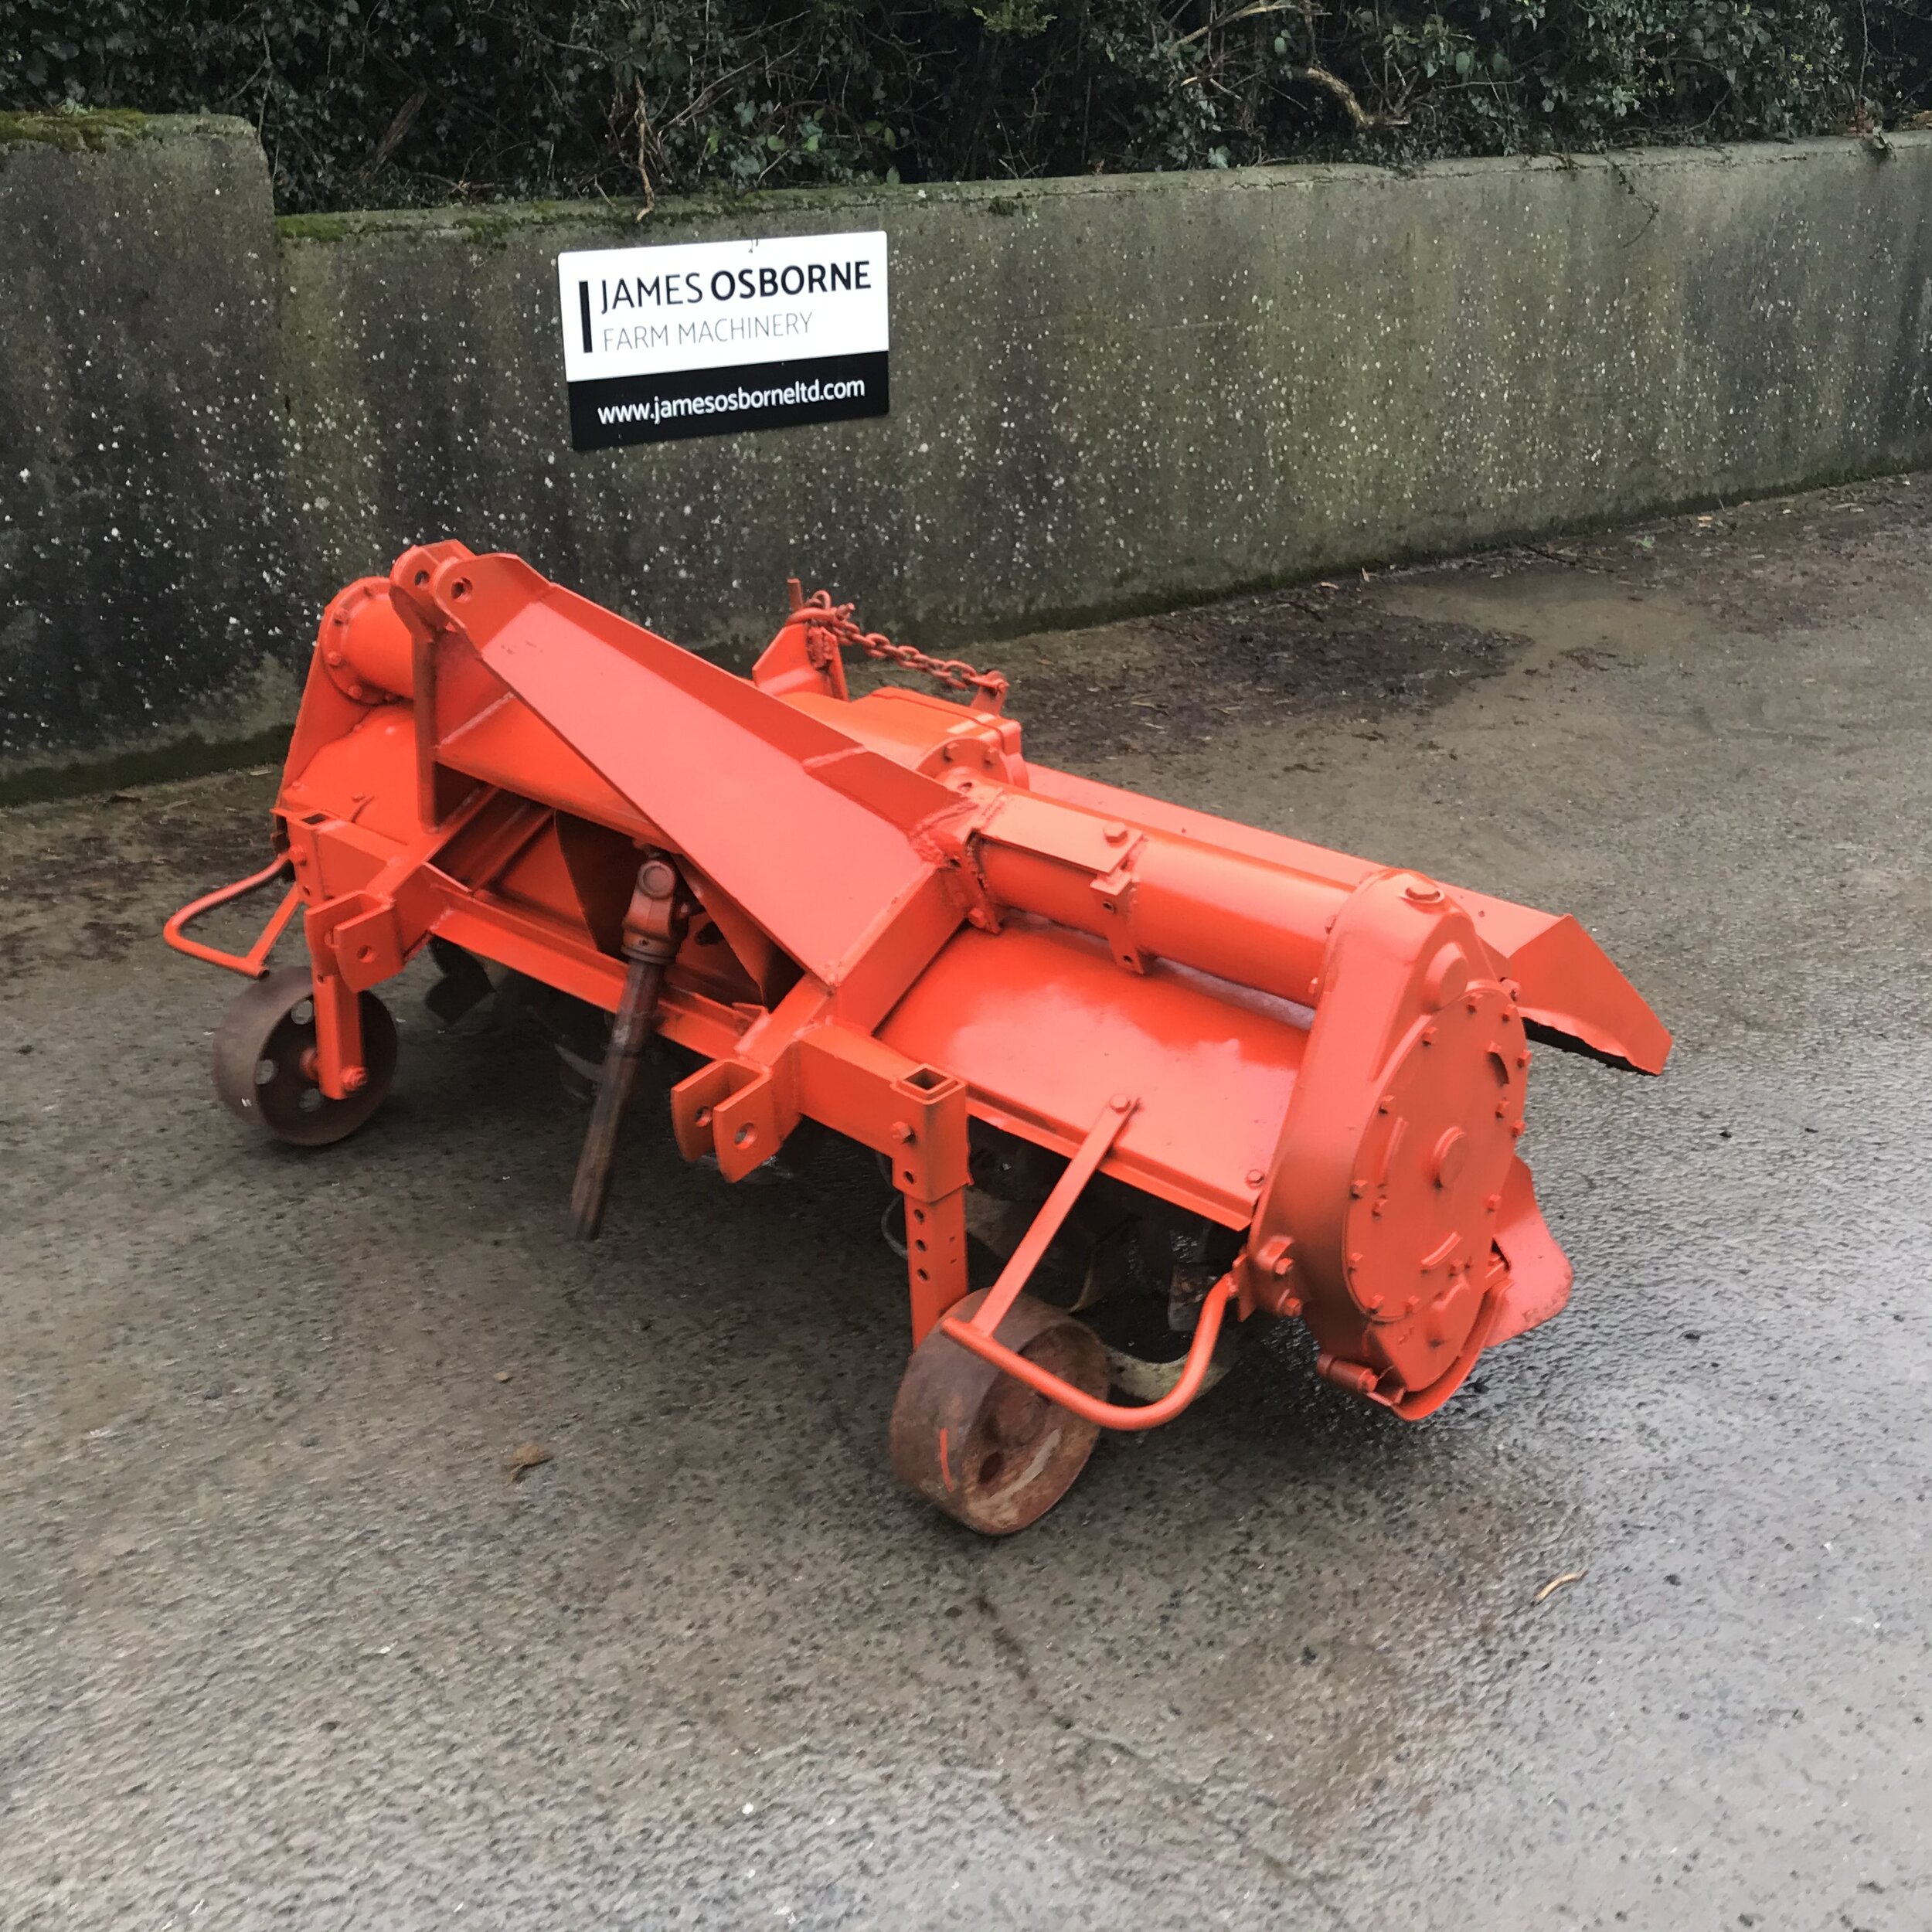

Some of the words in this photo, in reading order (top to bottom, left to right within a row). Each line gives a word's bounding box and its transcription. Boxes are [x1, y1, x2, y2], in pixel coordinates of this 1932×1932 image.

[601, 272, 703, 315] JAMES
[710, 260, 872, 301] OSBORNE
[604, 325, 668, 352] FARM
[679, 311, 813, 345] MACHINERY
[597, 379, 866, 425] www.jamesosborneltd.com
